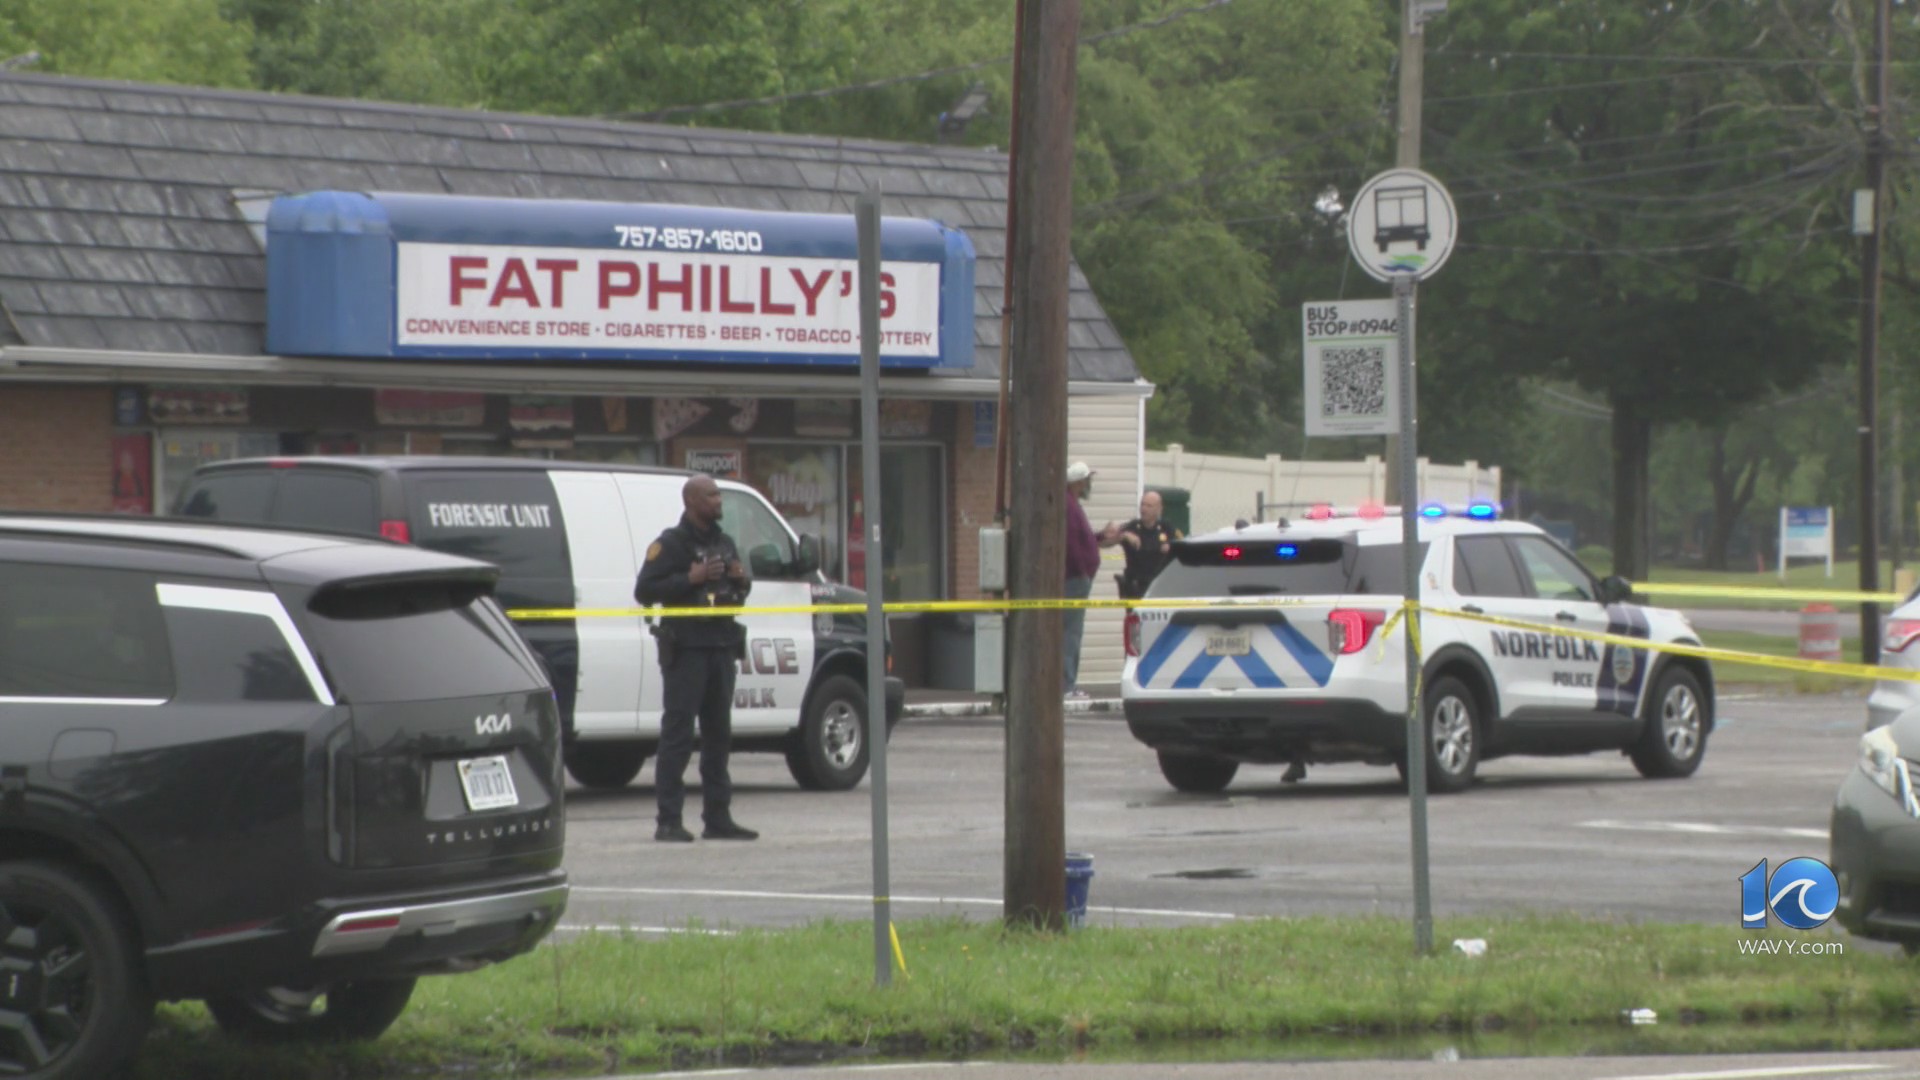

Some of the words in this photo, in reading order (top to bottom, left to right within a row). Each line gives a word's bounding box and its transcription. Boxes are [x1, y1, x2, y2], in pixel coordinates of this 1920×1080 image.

[449, 256, 579, 308] FAT
[1307, 306, 1338, 321] BUS
[406, 319, 530, 336] CONVENIENCE
[536, 321, 590, 337] STORE
[605, 323, 707, 340] CIGARETTES
[720, 326, 762, 341] BEER
[776, 327, 851, 344] TOBACCO
[687, 452, 738, 473] Newport
[428, 503, 510, 528] FORENSIC
[514, 505, 551, 529] UNIT
[1491, 631, 1599, 662] NORFOLK
[1553, 672, 1594, 688] POLICE
[475, 713, 512, 735] KIA
[427, 820, 551, 844] TELLURIDE
